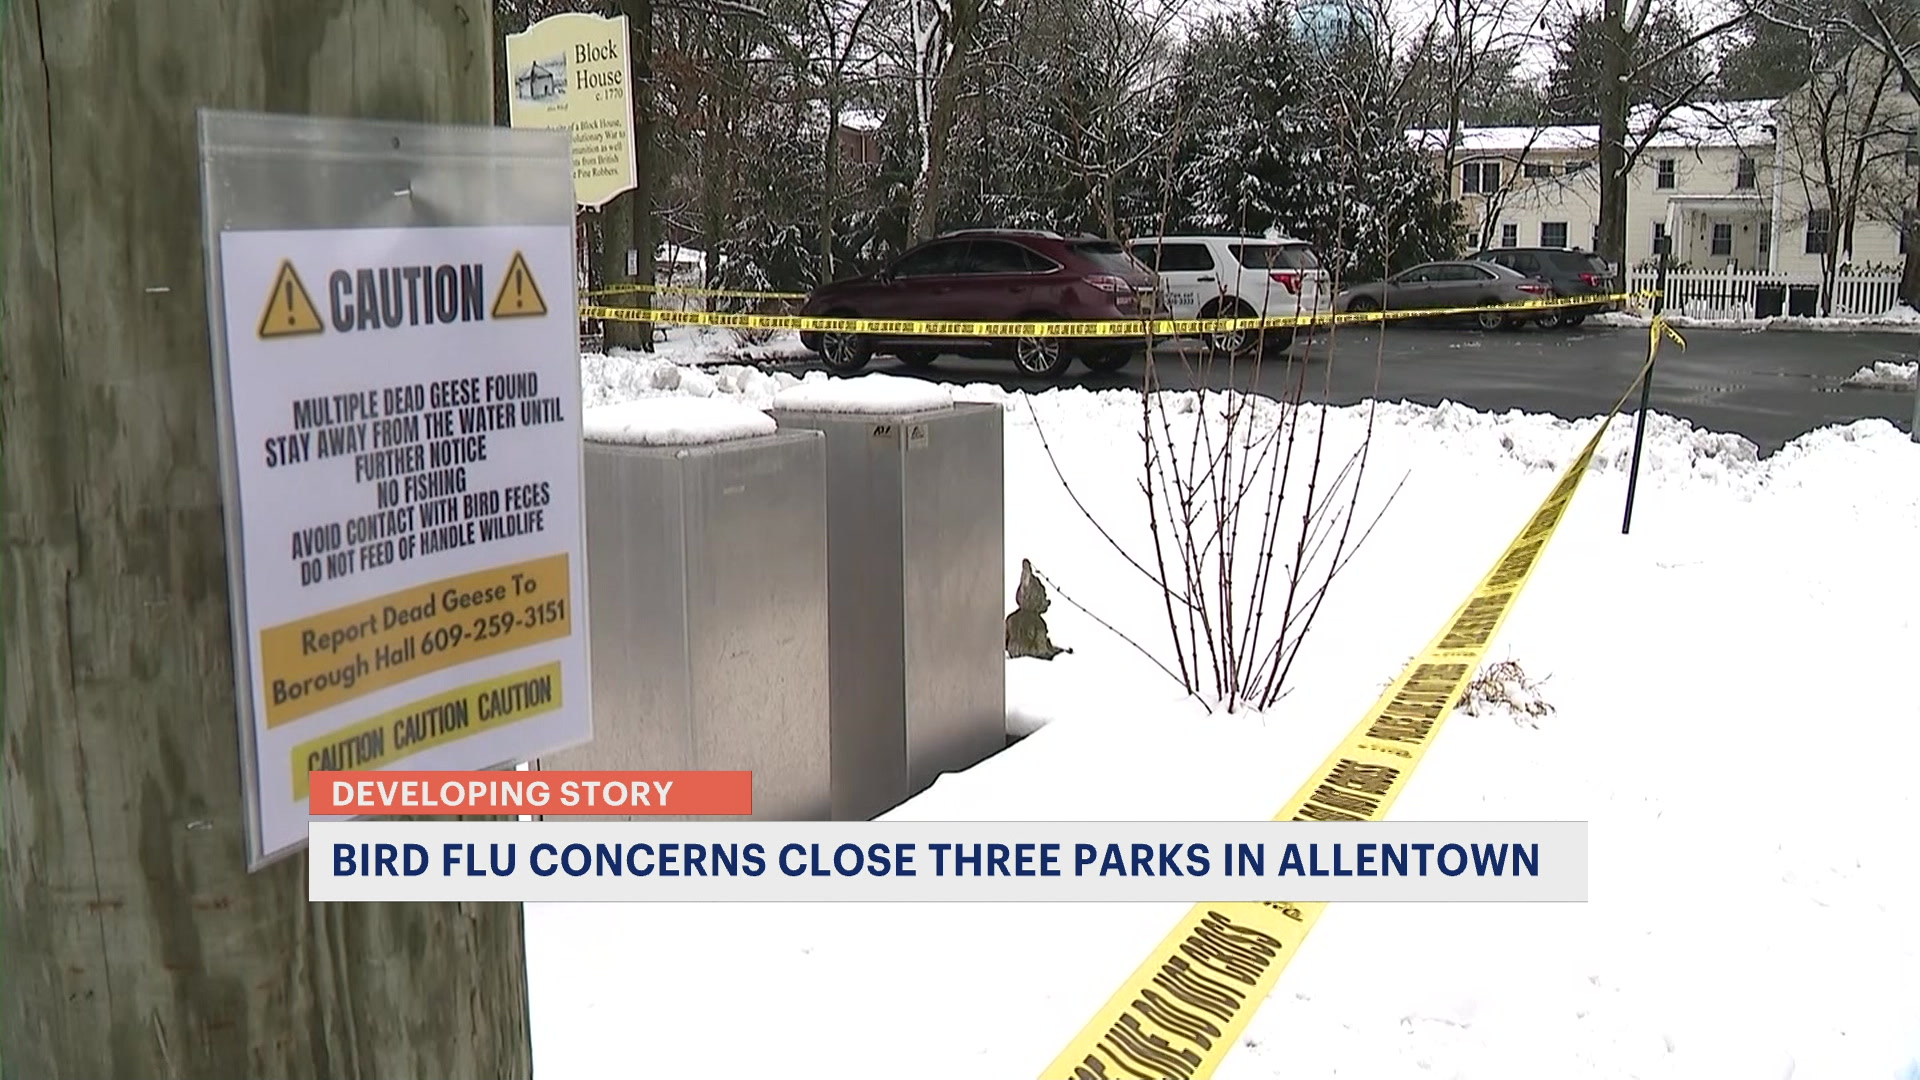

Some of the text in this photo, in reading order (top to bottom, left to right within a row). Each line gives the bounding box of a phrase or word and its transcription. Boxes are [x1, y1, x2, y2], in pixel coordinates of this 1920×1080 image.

[575, 39, 618, 64] Block
[576, 69, 623, 90] House
[602, 88, 623, 101] 1770
[329, 264, 485, 333] CAUTION
[265, 397, 564, 469] STAY AWAY FROM THE WATER UNTIL
[293, 371, 538, 430] MULTIPLE DEAD GEESE FOUND
[355, 435, 487, 483] FURTHER NOTICE
[377, 467, 467, 509] NO FISHING
[292, 482, 550, 560] AVOID CONTACT WITH BIRD FECES
[301, 509, 544, 587] DO NOT FEED OF HANDLE WILDLIFE
[302, 573, 537, 655] Report Dead Geese To
[272, 599, 566, 706] Borough Hall 609-259-3151
[308, 675, 553, 771] CAUTION CAUTION CAUTION
[1324, 758, 1400, 795] CROSS
[1179, 909, 1283, 986] CROSS
[1131, 988, 1221, 1051] DO
[1151, 955, 1247, 1023] NOT
